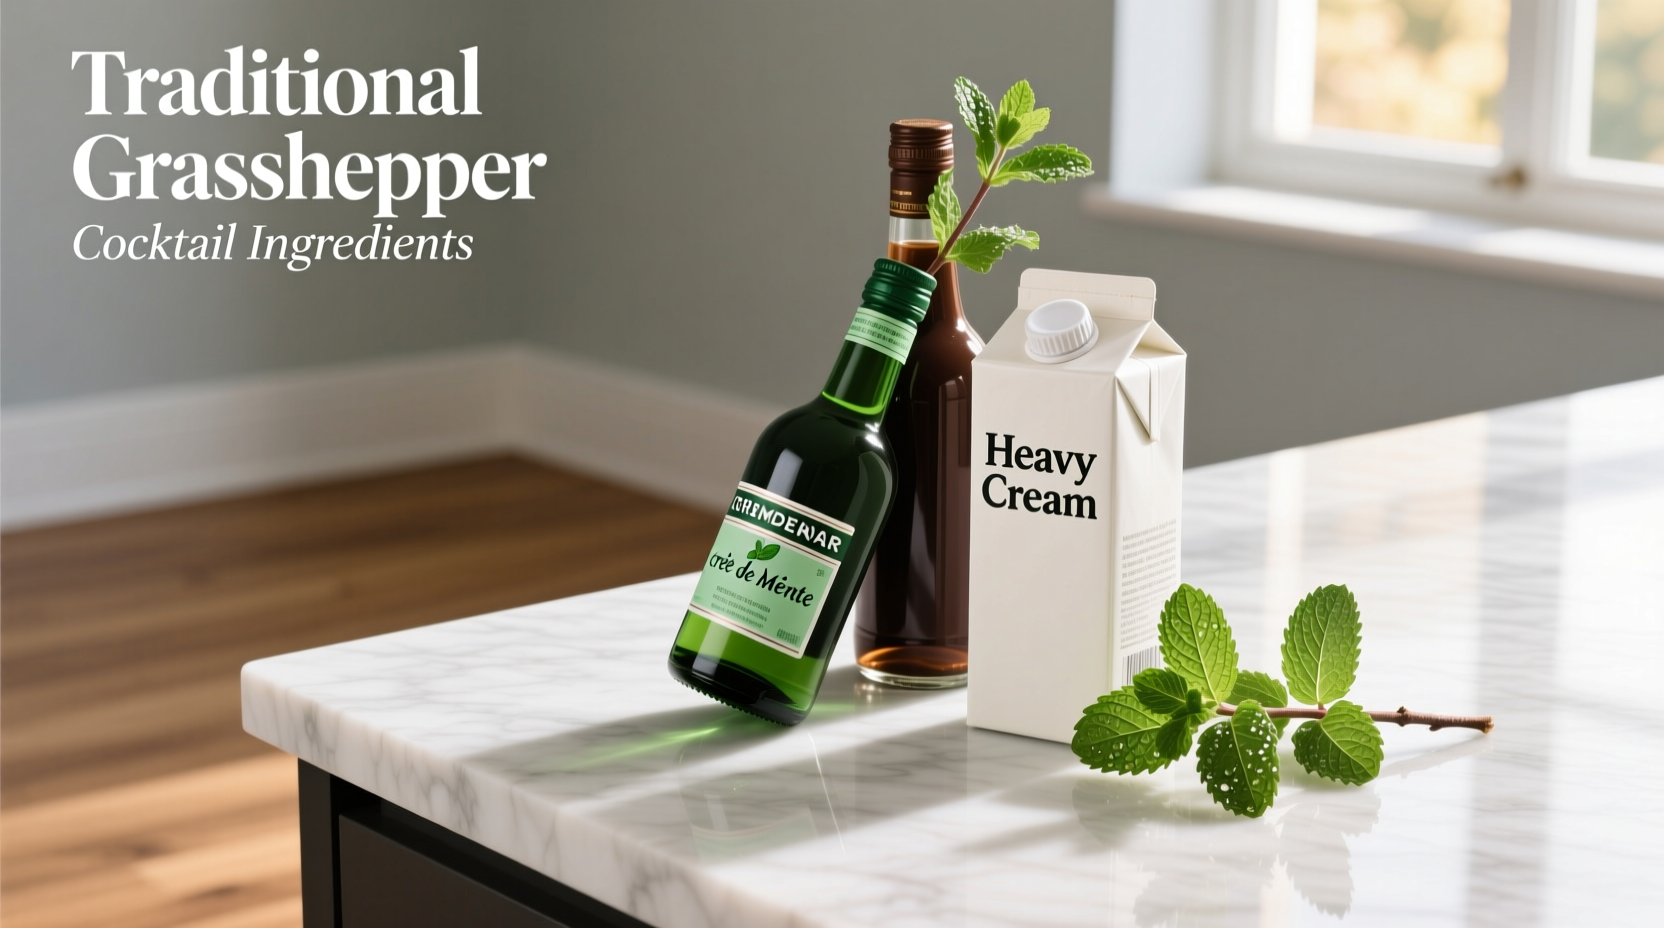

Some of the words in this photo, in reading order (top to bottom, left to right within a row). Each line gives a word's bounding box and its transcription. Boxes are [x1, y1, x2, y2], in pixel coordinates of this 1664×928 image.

[985, 432, 1098, 486] Heavy
[981, 473, 1098, 520] Cream
[735, 560, 755, 582] de
